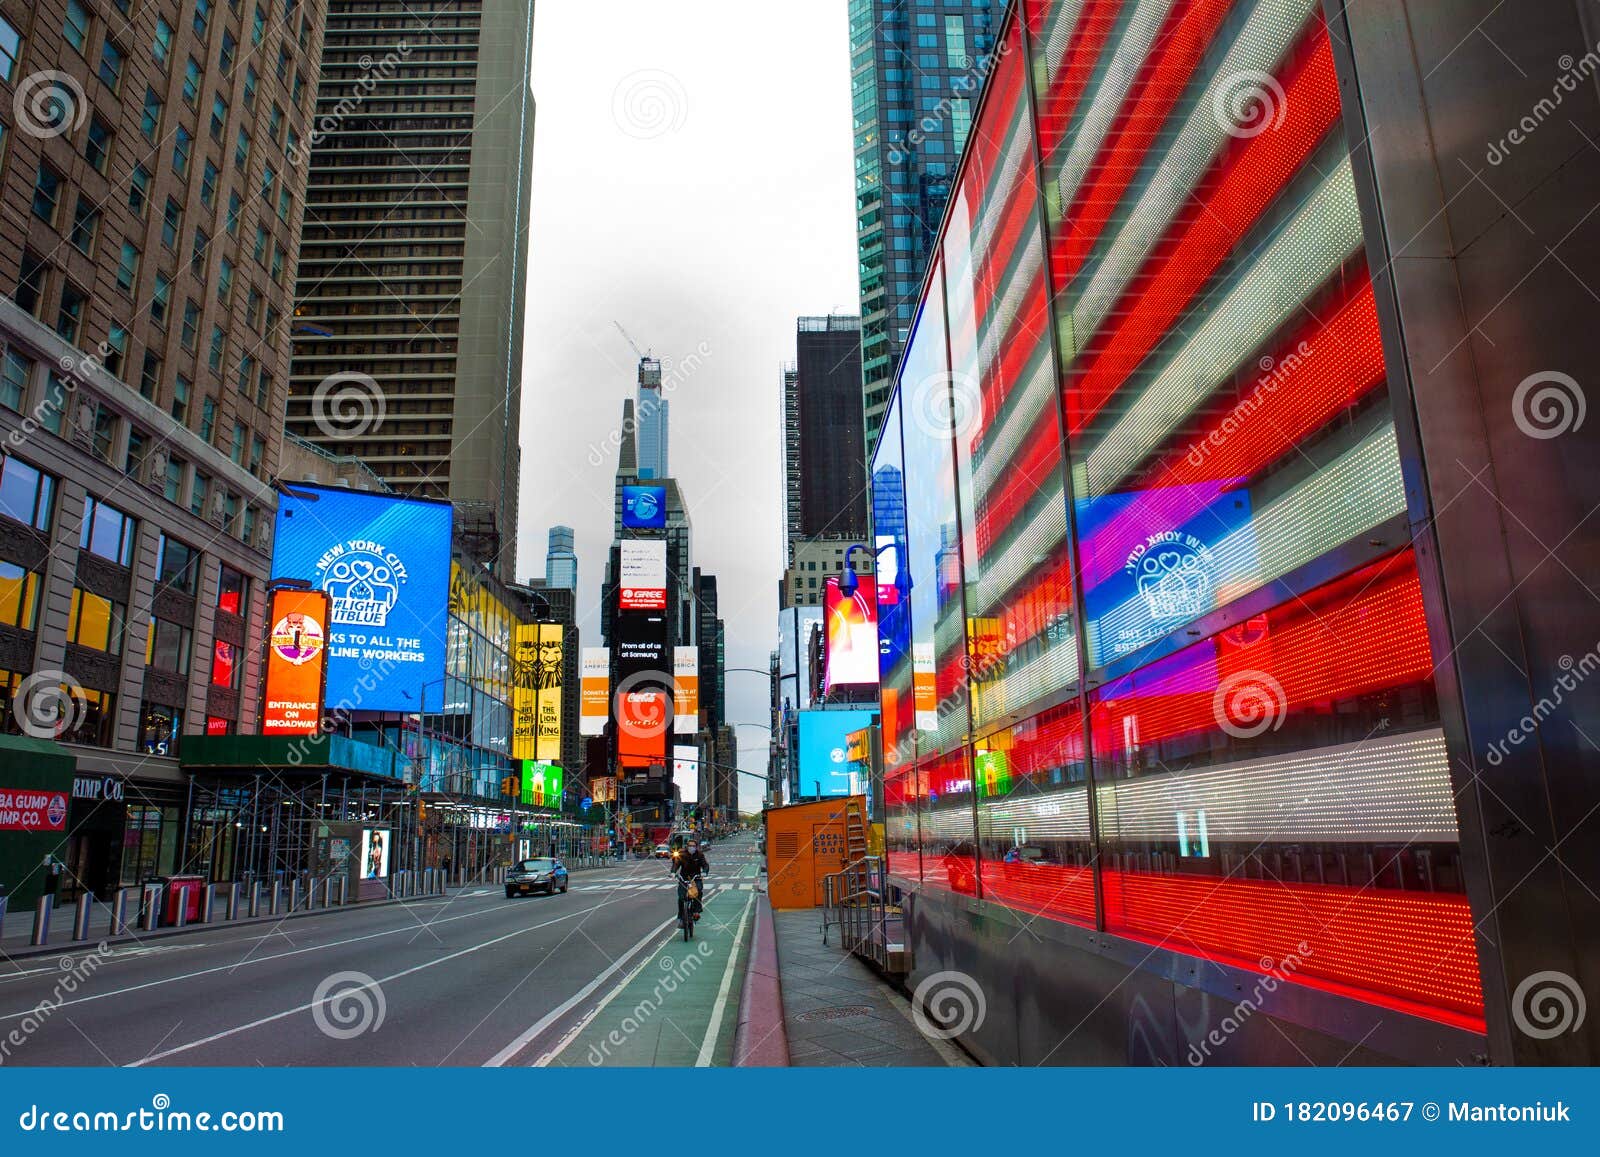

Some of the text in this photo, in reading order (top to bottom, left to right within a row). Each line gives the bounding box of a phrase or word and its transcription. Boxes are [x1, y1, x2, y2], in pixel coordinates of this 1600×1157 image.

[316, 540, 408, 579] NEW YORK CITY
[634, 590, 663, 599] GREE
[334, 599, 384, 612] #LIGHT
[334, 610, 383, 624] ITBLUE
[349, 634, 366, 645] TO
[370, 635, 393, 646] ALL
[397, 637, 421, 649] THE
[622, 642, 637, 650] From
[328, 646, 425, 663] LINE WORKERS
[630, 651, 658, 659] Samsung
[268, 701, 317, 710] ENTRANCE
[285, 710, 299, 719] ON
[540, 713, 557, 723] LION
[265, 719, 317, 728] BROADWAY
[538, 724, 559, 737] KING
[16, 795, 48, 809] GUMP
[22, 811, 41, 825] CO.
